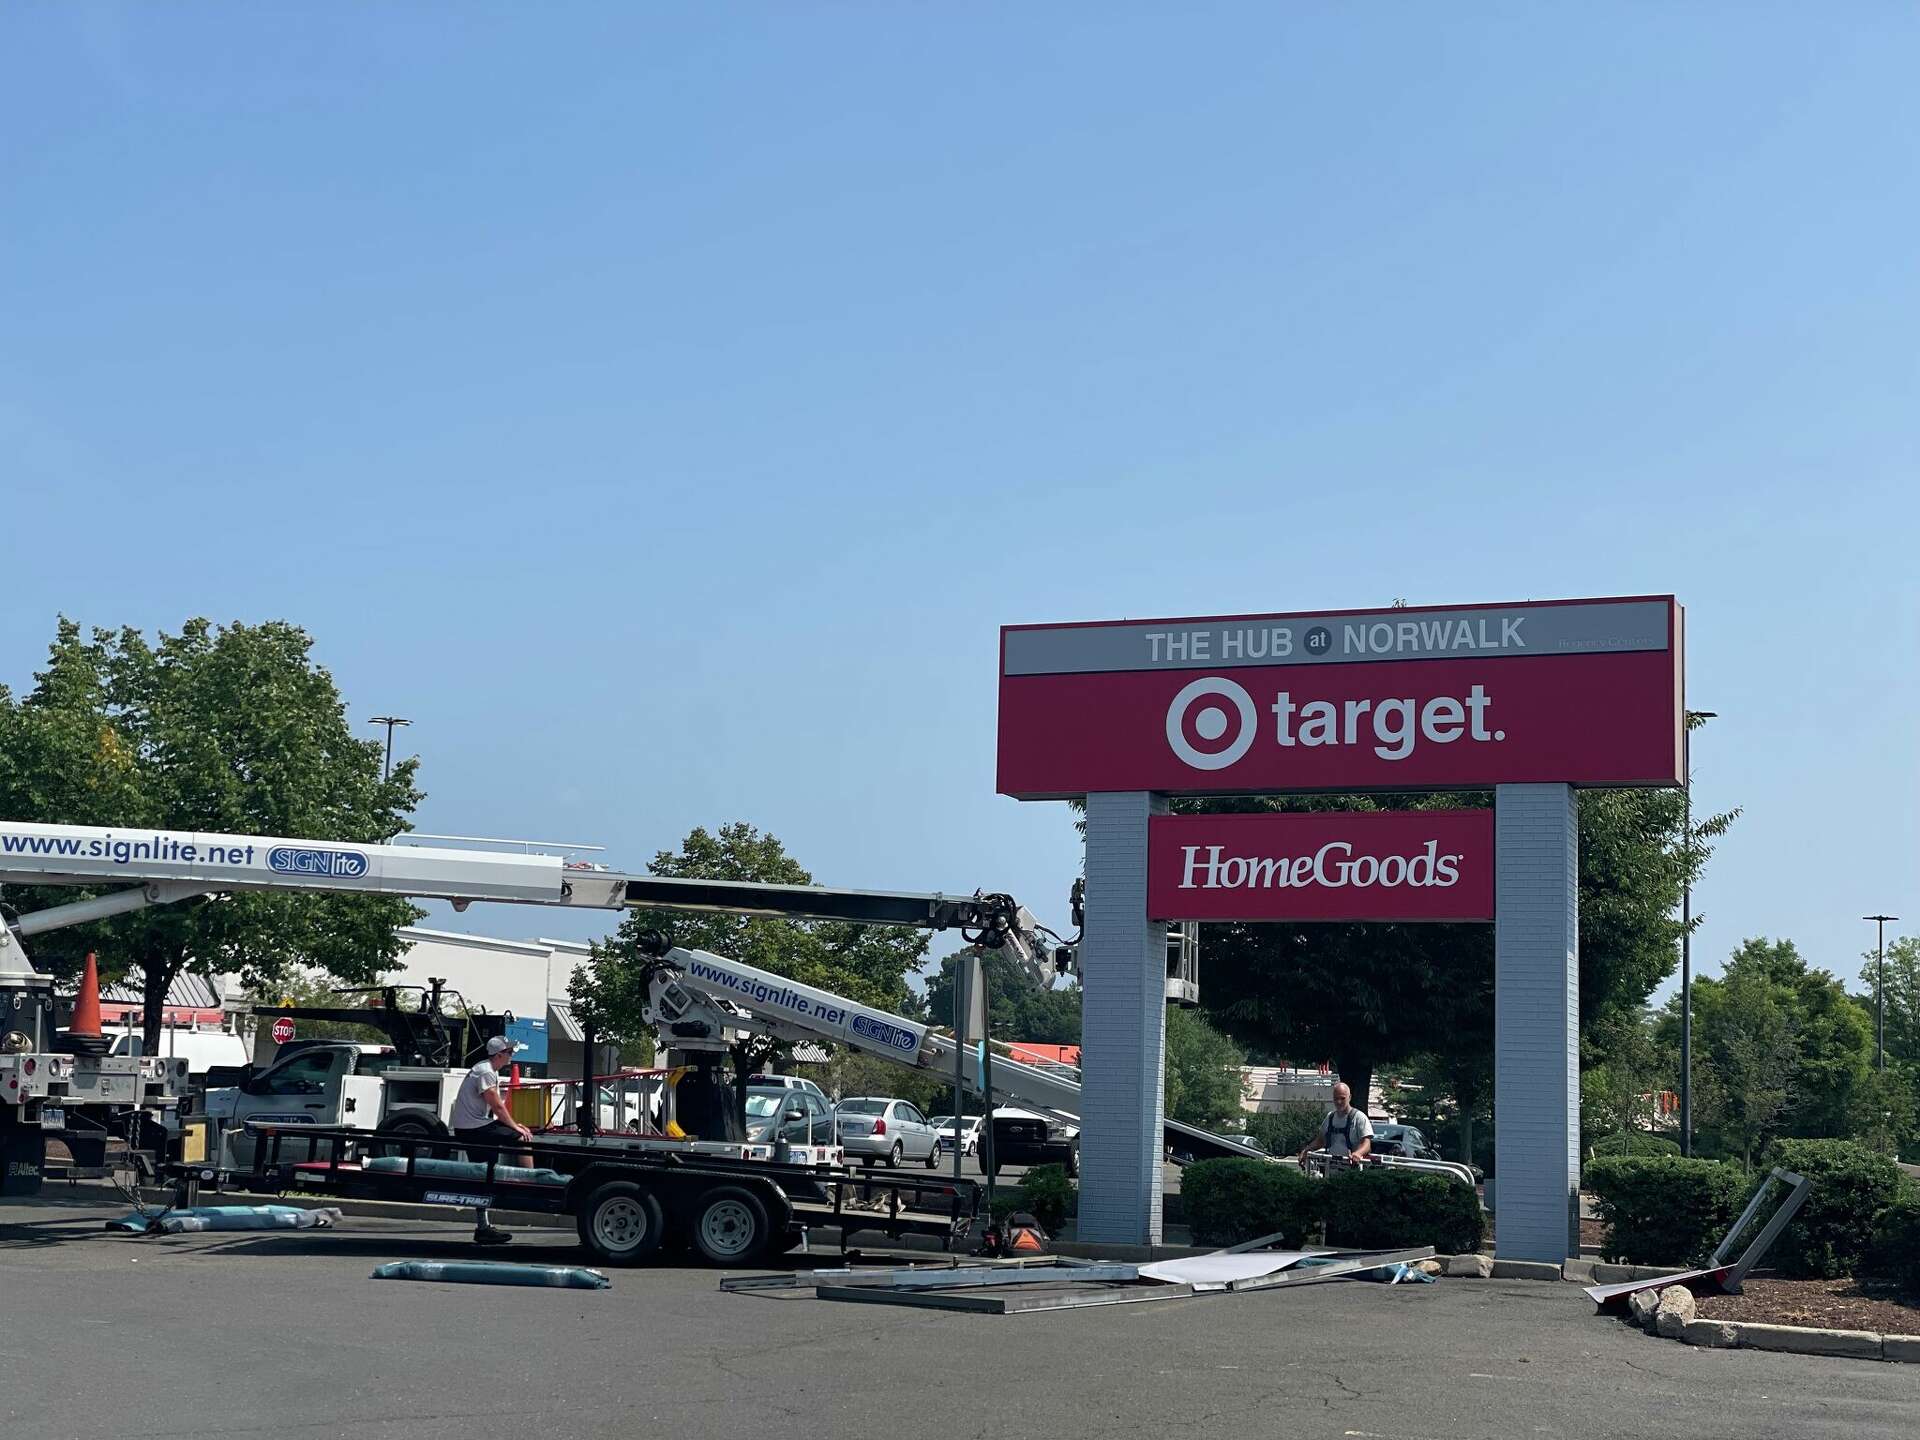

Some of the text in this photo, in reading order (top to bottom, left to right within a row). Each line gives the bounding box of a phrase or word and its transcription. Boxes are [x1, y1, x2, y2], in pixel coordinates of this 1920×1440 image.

[1145, 617, 1526, 662] THE HUB at NORWALK
[2, 833, 254, 864] www.signlite.net
[1178, 839, 1464, 889] HomeGoods
[691, 961, 847, 1026] www.signlite.net
[274, 1025, 294, 1037] STOP
